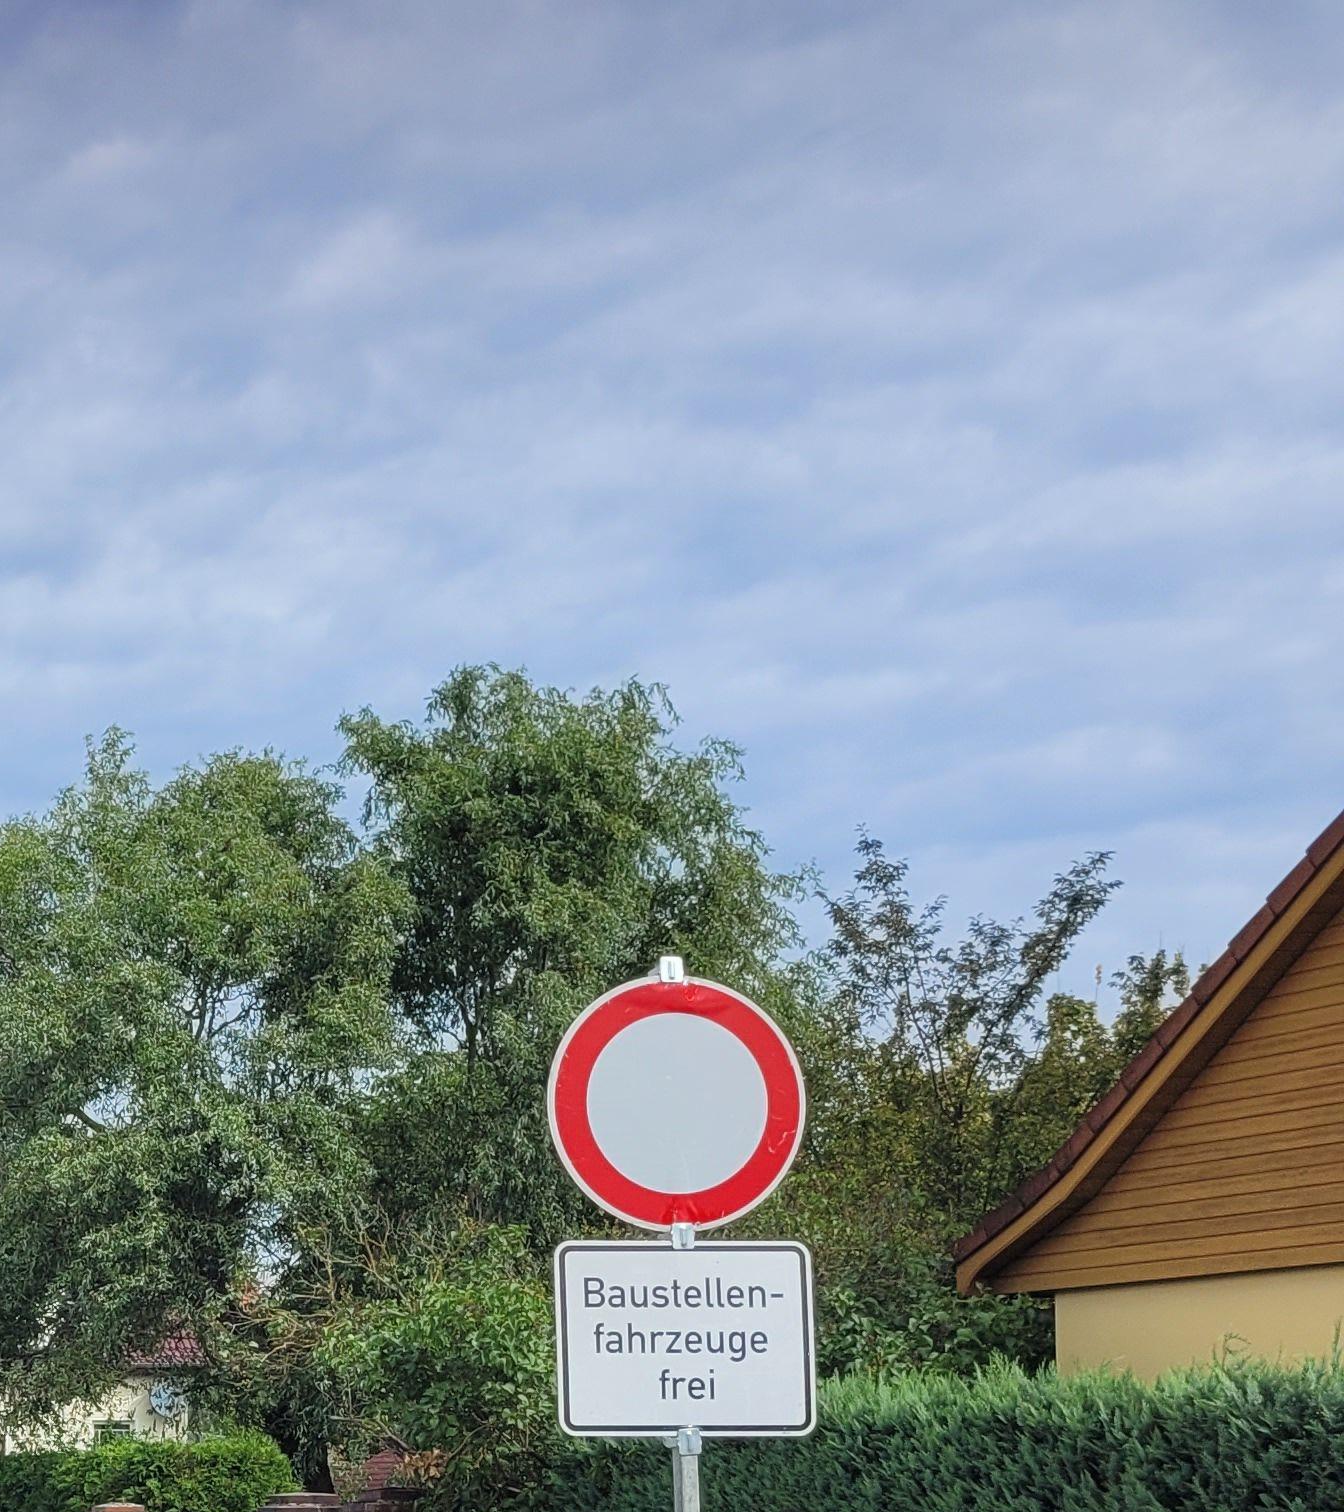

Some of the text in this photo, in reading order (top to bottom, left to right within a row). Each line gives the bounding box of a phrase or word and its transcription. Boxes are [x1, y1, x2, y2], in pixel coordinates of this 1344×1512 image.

[583, 1277, 784, 1309] Baustellen-
[593, 1322, 769, 1363] fahrzeuge
[658, 1368, 716, 1400] frei
